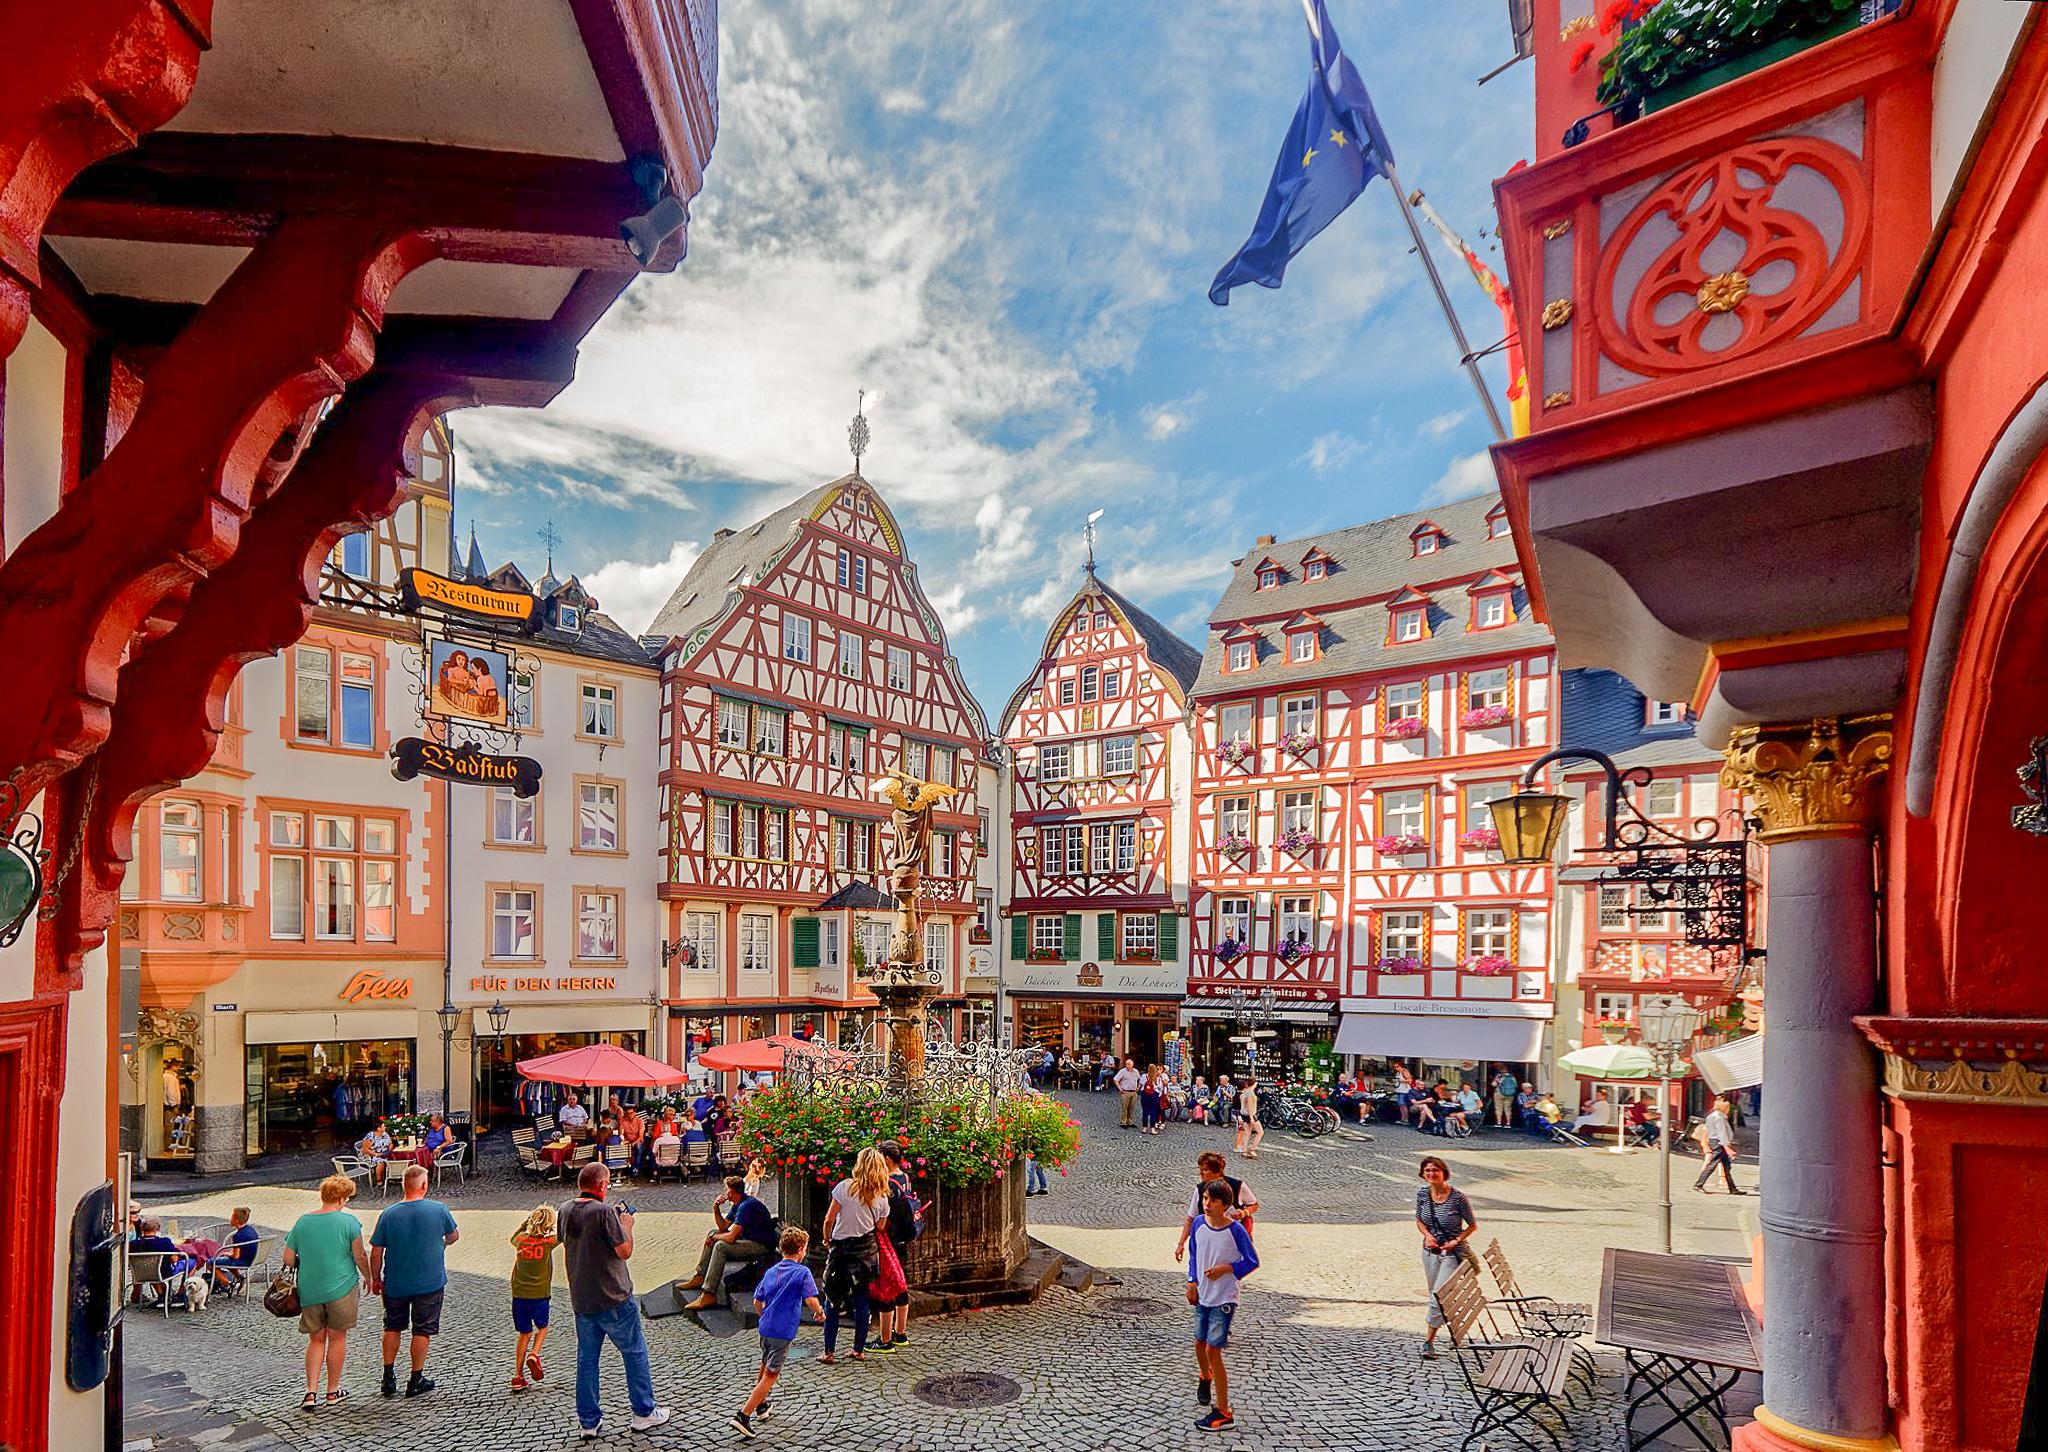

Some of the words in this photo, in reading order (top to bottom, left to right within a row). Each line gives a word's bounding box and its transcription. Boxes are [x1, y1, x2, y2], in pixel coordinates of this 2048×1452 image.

[427, 580, 520, 613] Restaurant
[471, 975, 507, 991] FÜR
[515, 977, 551, 991] DEN
[558, 976, 616, 991] HERRN
